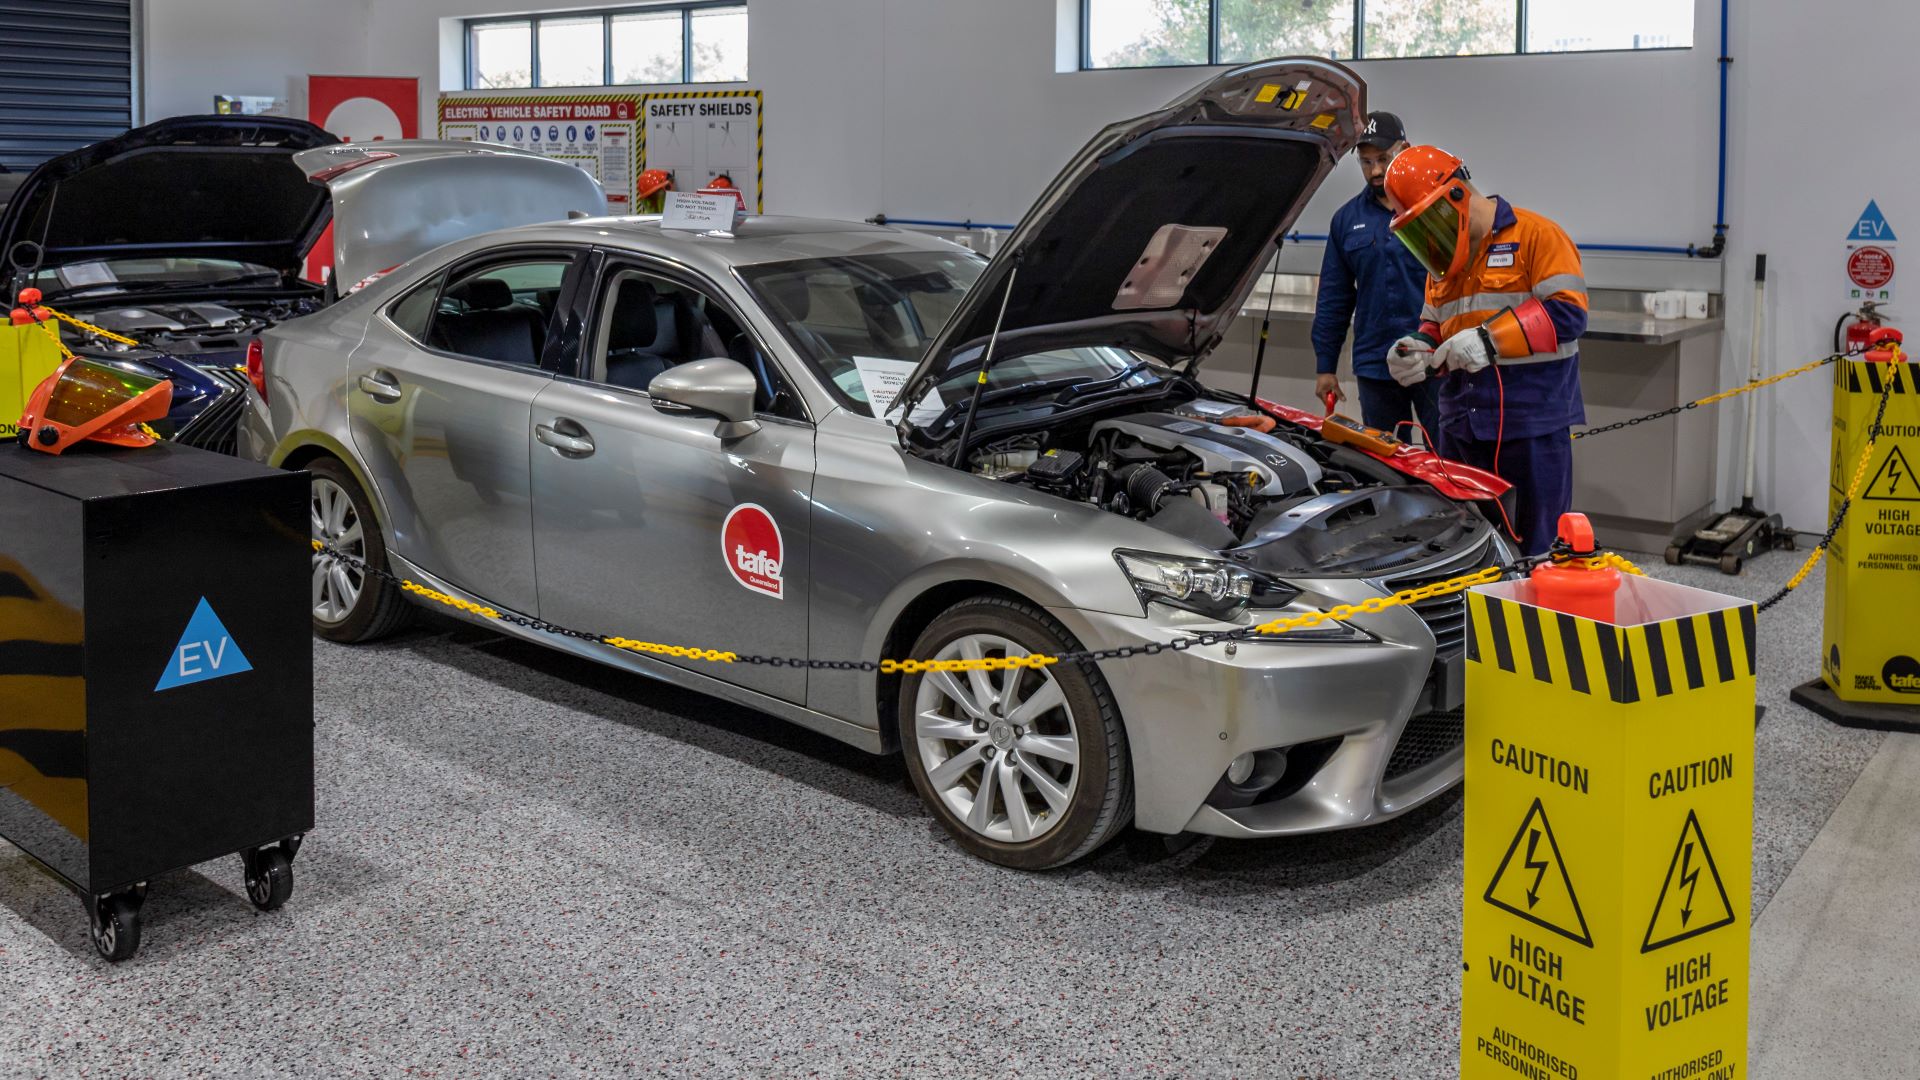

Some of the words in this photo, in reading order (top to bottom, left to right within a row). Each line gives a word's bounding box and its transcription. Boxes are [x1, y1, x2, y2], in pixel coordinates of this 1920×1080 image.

[445, 107, 488, 119] ELECTRIC
[490, 106, 532, 118] VEHICLE
[533, 105, 572, 118] SAFETY
[574, 104, 611, 117] BOARD
[650, 104, 695, 117] SAFETY
[699, 102, 752, 116] SHIELDS
[1858, 220, 1885, 237] EV
[1865, 523, 1920, 536] VOLTAGE
[1878, 509, 1910, 522] HIGH
[736, 544, 780, 580] tafe
[1858, 561, 1905, 571] PERSONNEL
[1867, 553, 1918, 562] AUTHORISED
[749, 576, 778, 590] Queensland
[180, 636, 228, 677] EV
[1491, 738, 1589, 795] CAUTION
[1649, 753, 1733, 800] CAUTION
[1510, 934, 1563, 982] HIGH
[1665, 952, 1711, 992] HIGH
[1488, 956, 1585, 1026] VOLTAGE
[1645, 978, 1729, 1032] VOLTAGE
[1493, 1026, 1578, 1080] AUTHORISED
